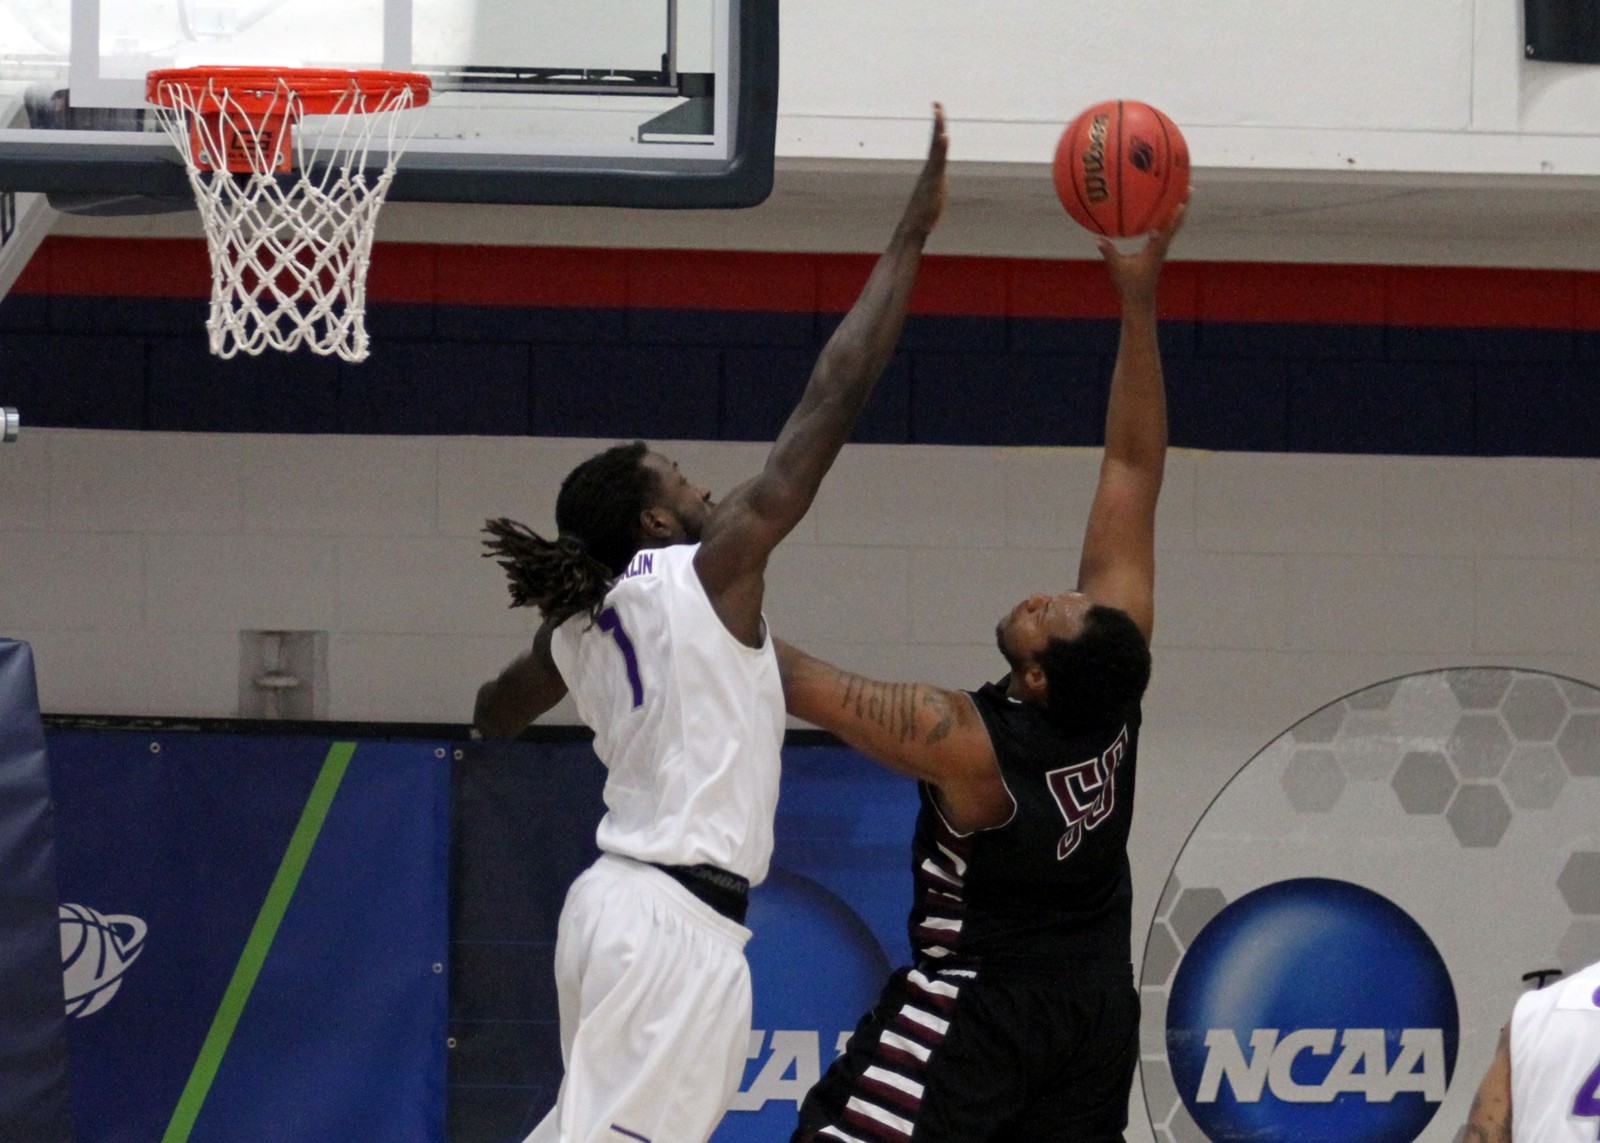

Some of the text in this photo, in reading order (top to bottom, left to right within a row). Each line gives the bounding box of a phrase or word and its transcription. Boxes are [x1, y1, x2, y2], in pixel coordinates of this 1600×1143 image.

[1083, 114, 1110, 202] Wilson
[597, 605, 645, 709] 1
[1045, 722, 1129, 862] 55
[1195, 1028, 1448, 1104] NCAA
